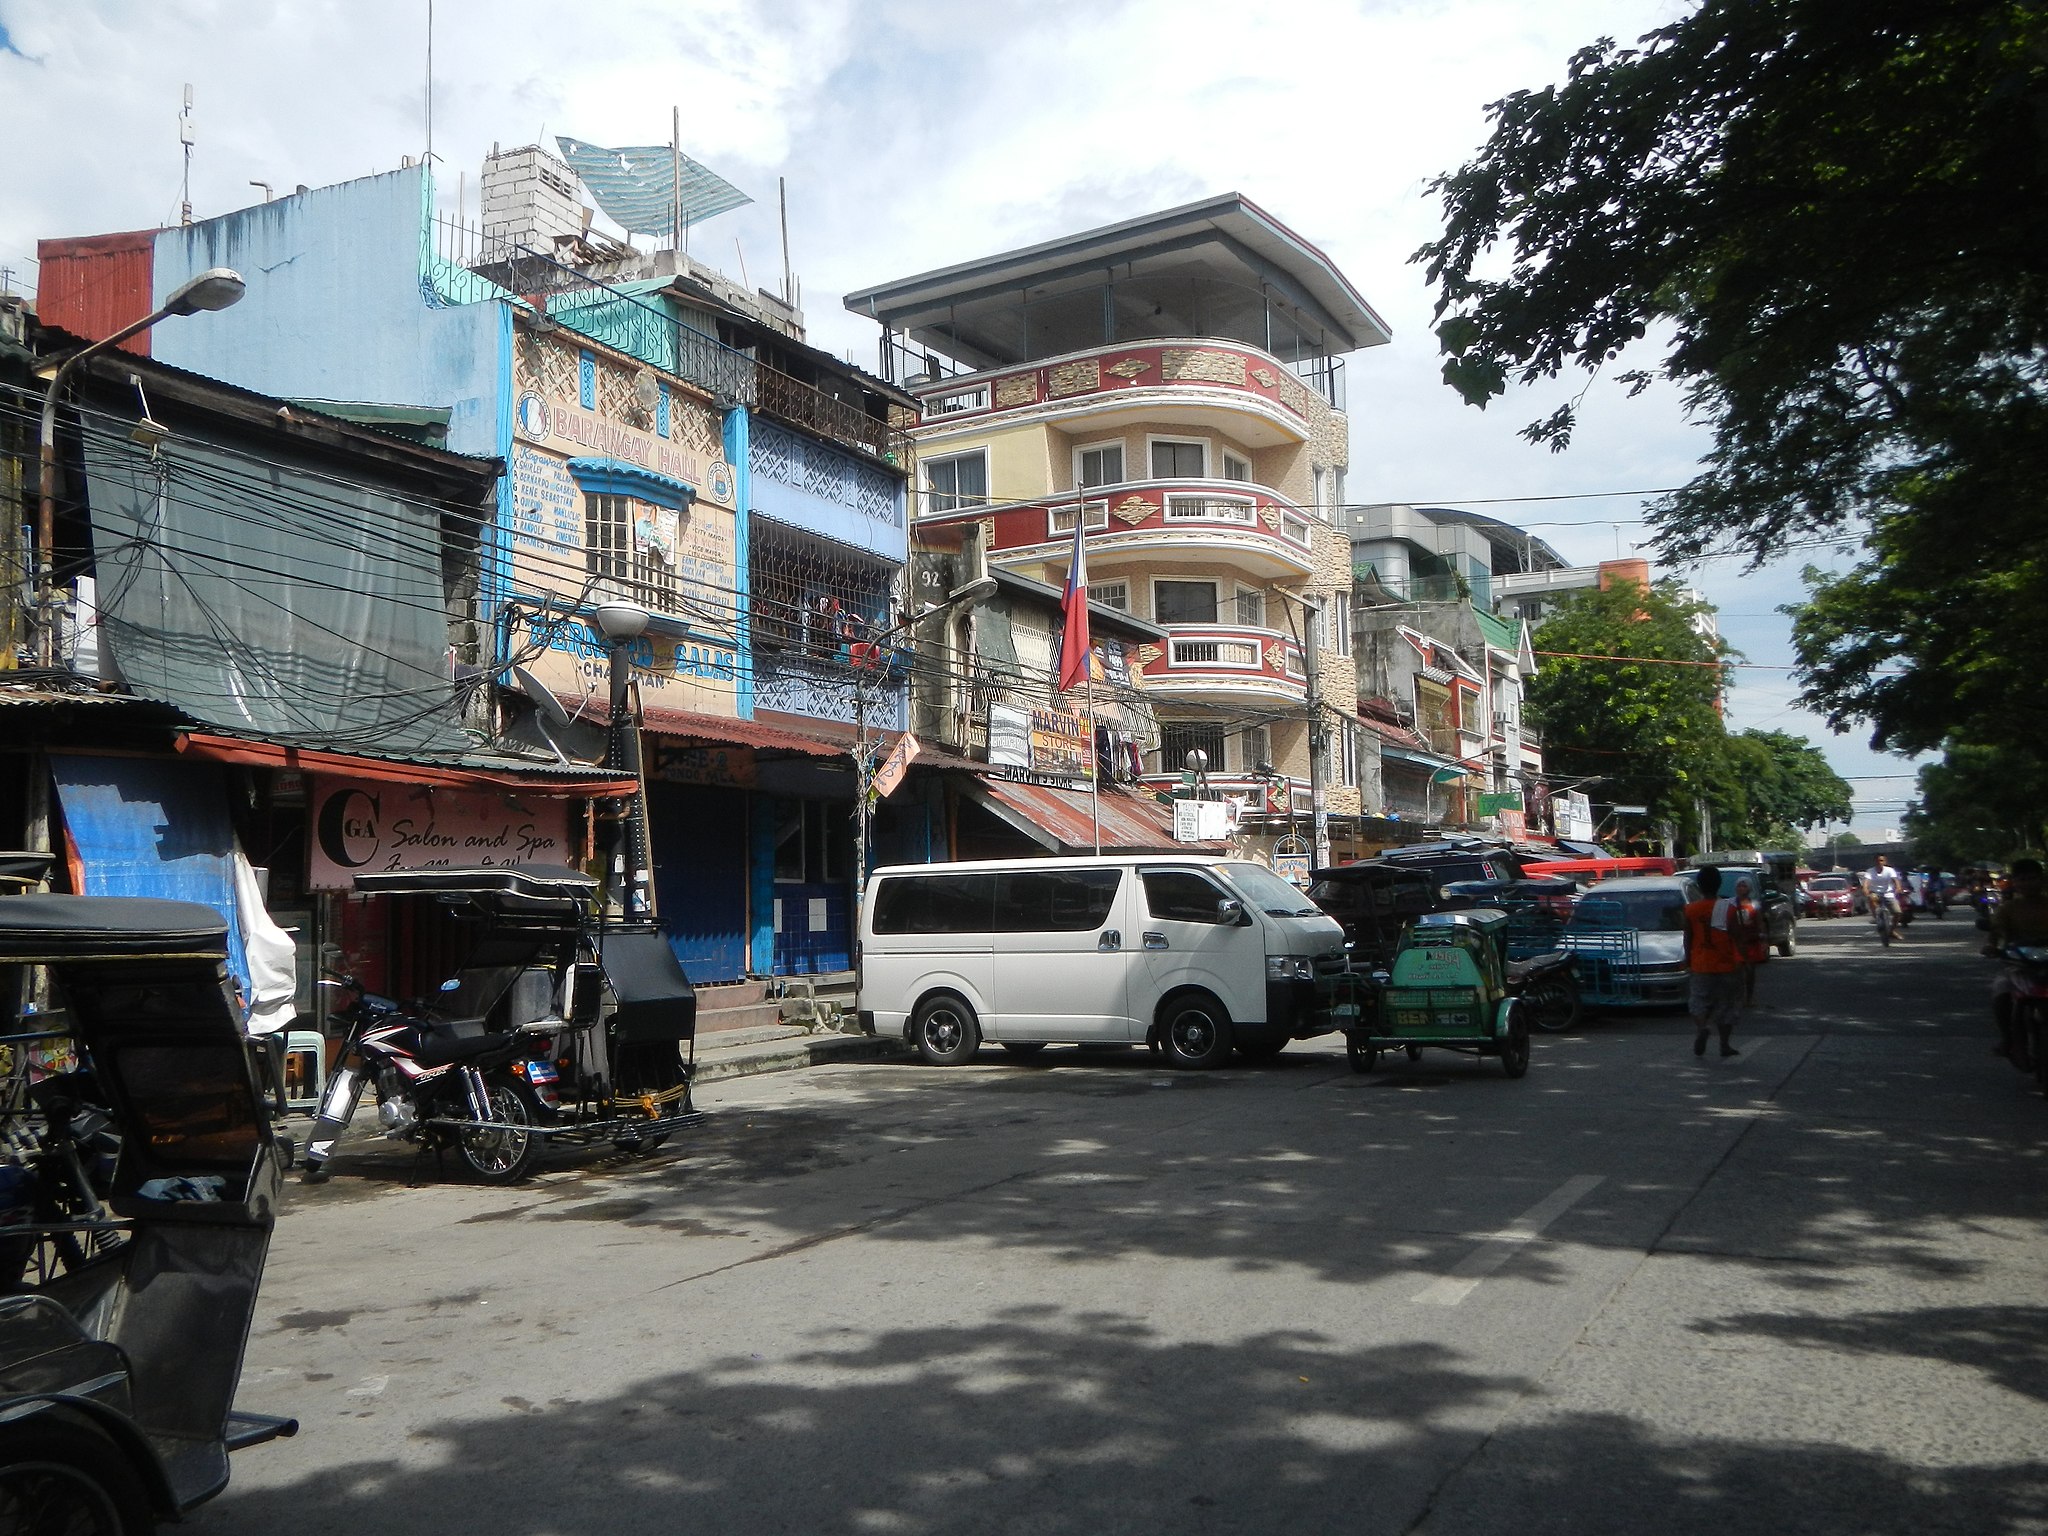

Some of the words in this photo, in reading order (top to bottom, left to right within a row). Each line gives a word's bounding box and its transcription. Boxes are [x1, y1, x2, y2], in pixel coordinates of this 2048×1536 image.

[554, 408, 653, 466] BARANGAY
[657, 444, 702, 486] HALL
[519, 472, 550, 489] BERNARDO
[555, 483, 578, 498] GABRIEL
[540, 489, 573, 508] SEBASTIAN
[708, 532, 725, 542] MAYOR
[921, 570, 941, 588] 92
[674, 643, 736, 682] SALAS
[1032, 709, 1080, 738] MARVIN
[1042, 734, 1076, 751] STORE
[391, 818, 458, 849] Salon
[464, 824, 509, 848] and
[515, 823, 556, 859] Spa
